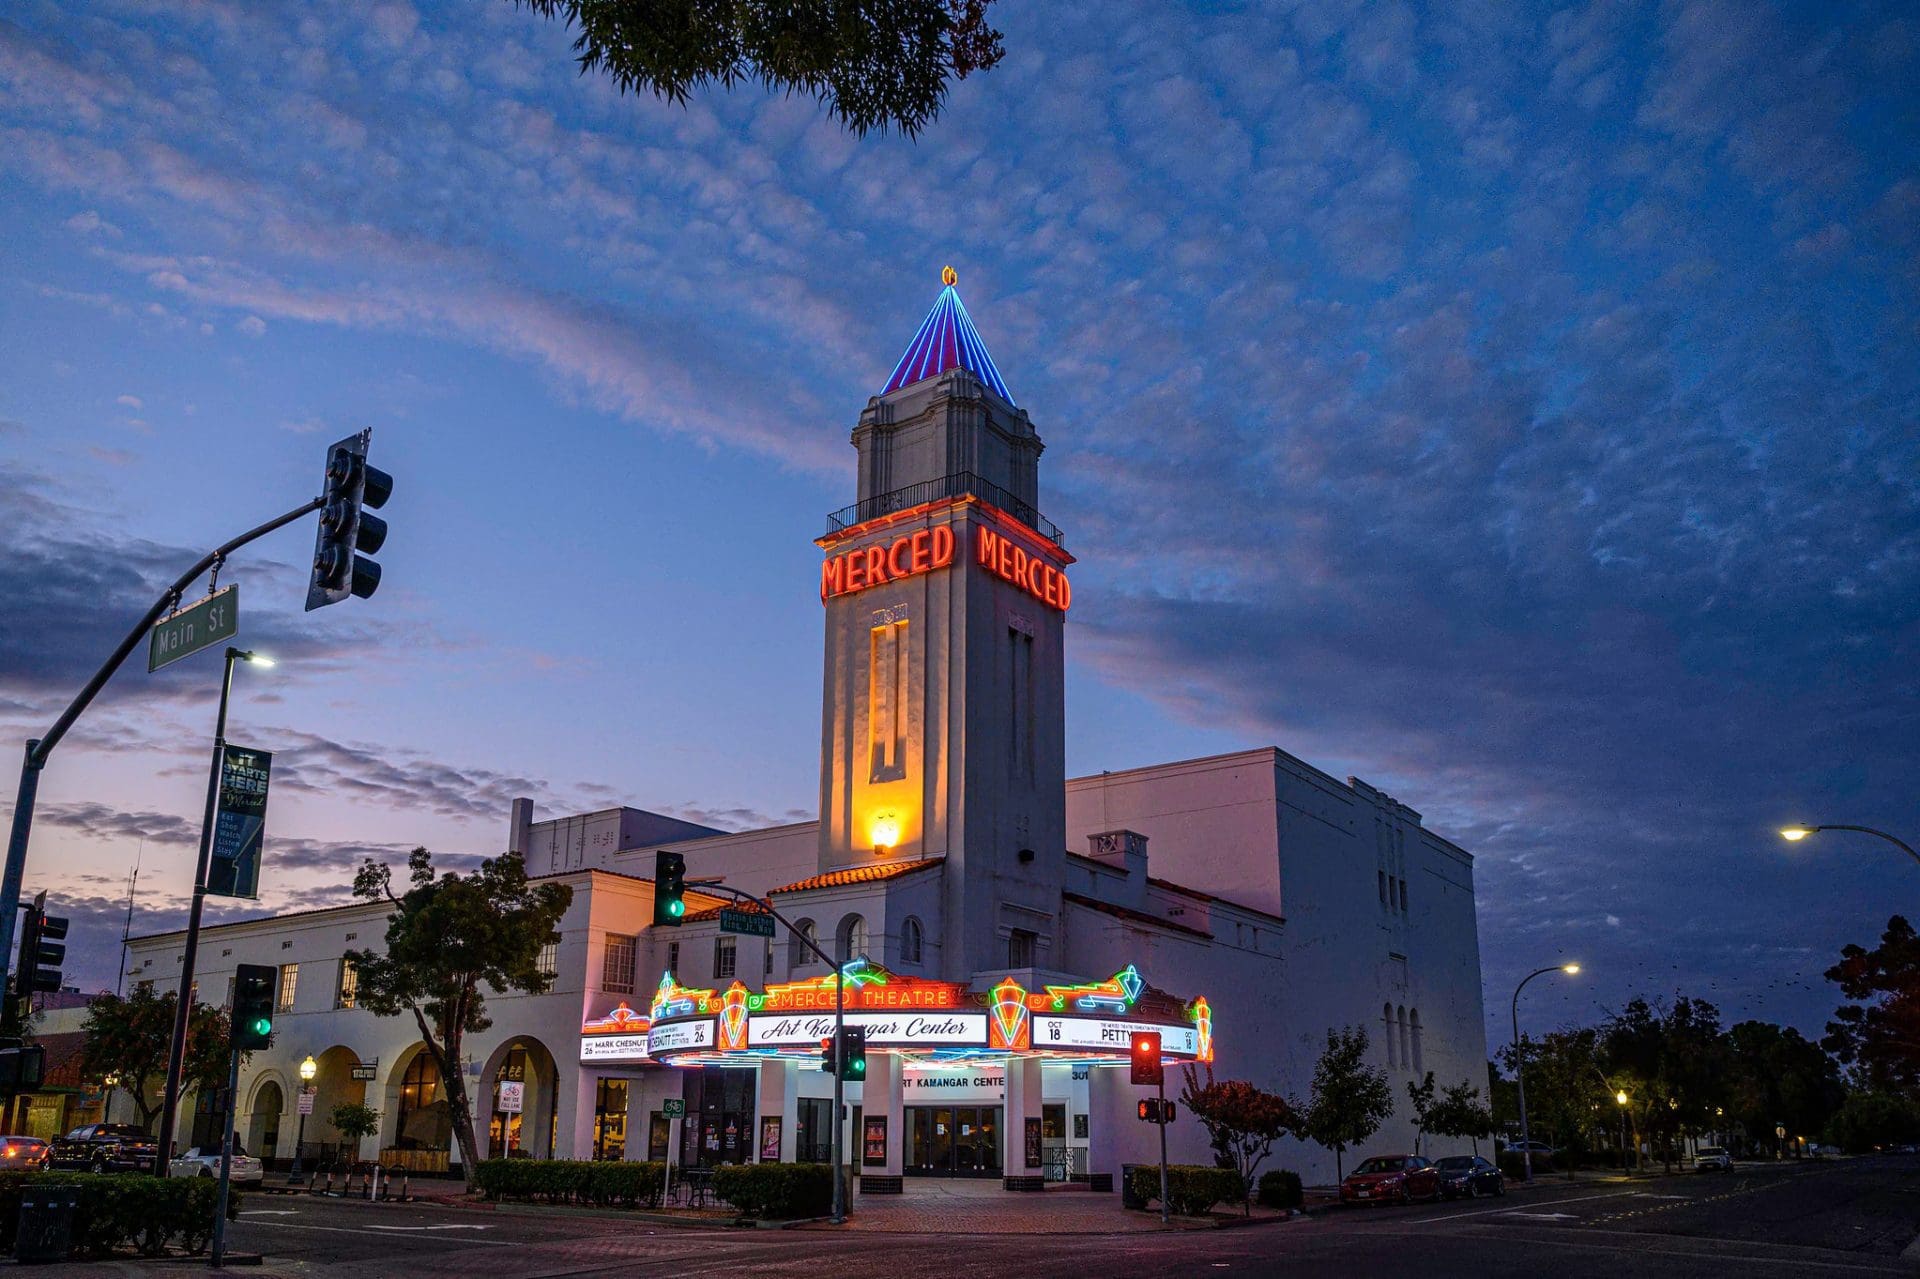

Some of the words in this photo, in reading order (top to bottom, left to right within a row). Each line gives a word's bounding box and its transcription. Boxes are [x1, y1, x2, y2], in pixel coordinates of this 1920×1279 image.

[821, 525, 956, 600] MERCED
[978, 525, 1071, 611] MERCED
[159, 623, 194, 655] Main
[208, 604, 225, 632] St
[223, 763, 268, 780] STARTS
[223, 773, 268, 794] HERE
[220, 822, 239, 832] Shop
[218, 838, 241, 848] Listen
[780, 990, 851, 1007] MERCED
[863, 990, 948, 1006] THEATRE
[761, 1019, 802, 1040] Art
[905, 1017, 968, 1038] Center
[1047, 1021, 1062, 1029] OCT
[695, 1031, 706, 1042] 26
[1049, 1029, 1061, 1041] 18
[595, 1040, 614, 1048] MARK
[917, 1077, 968, 1088] KAMANGAR
[973, 1076, 1004, 1087] CENTE
[1071, 1071, 1088, 1081] 301
